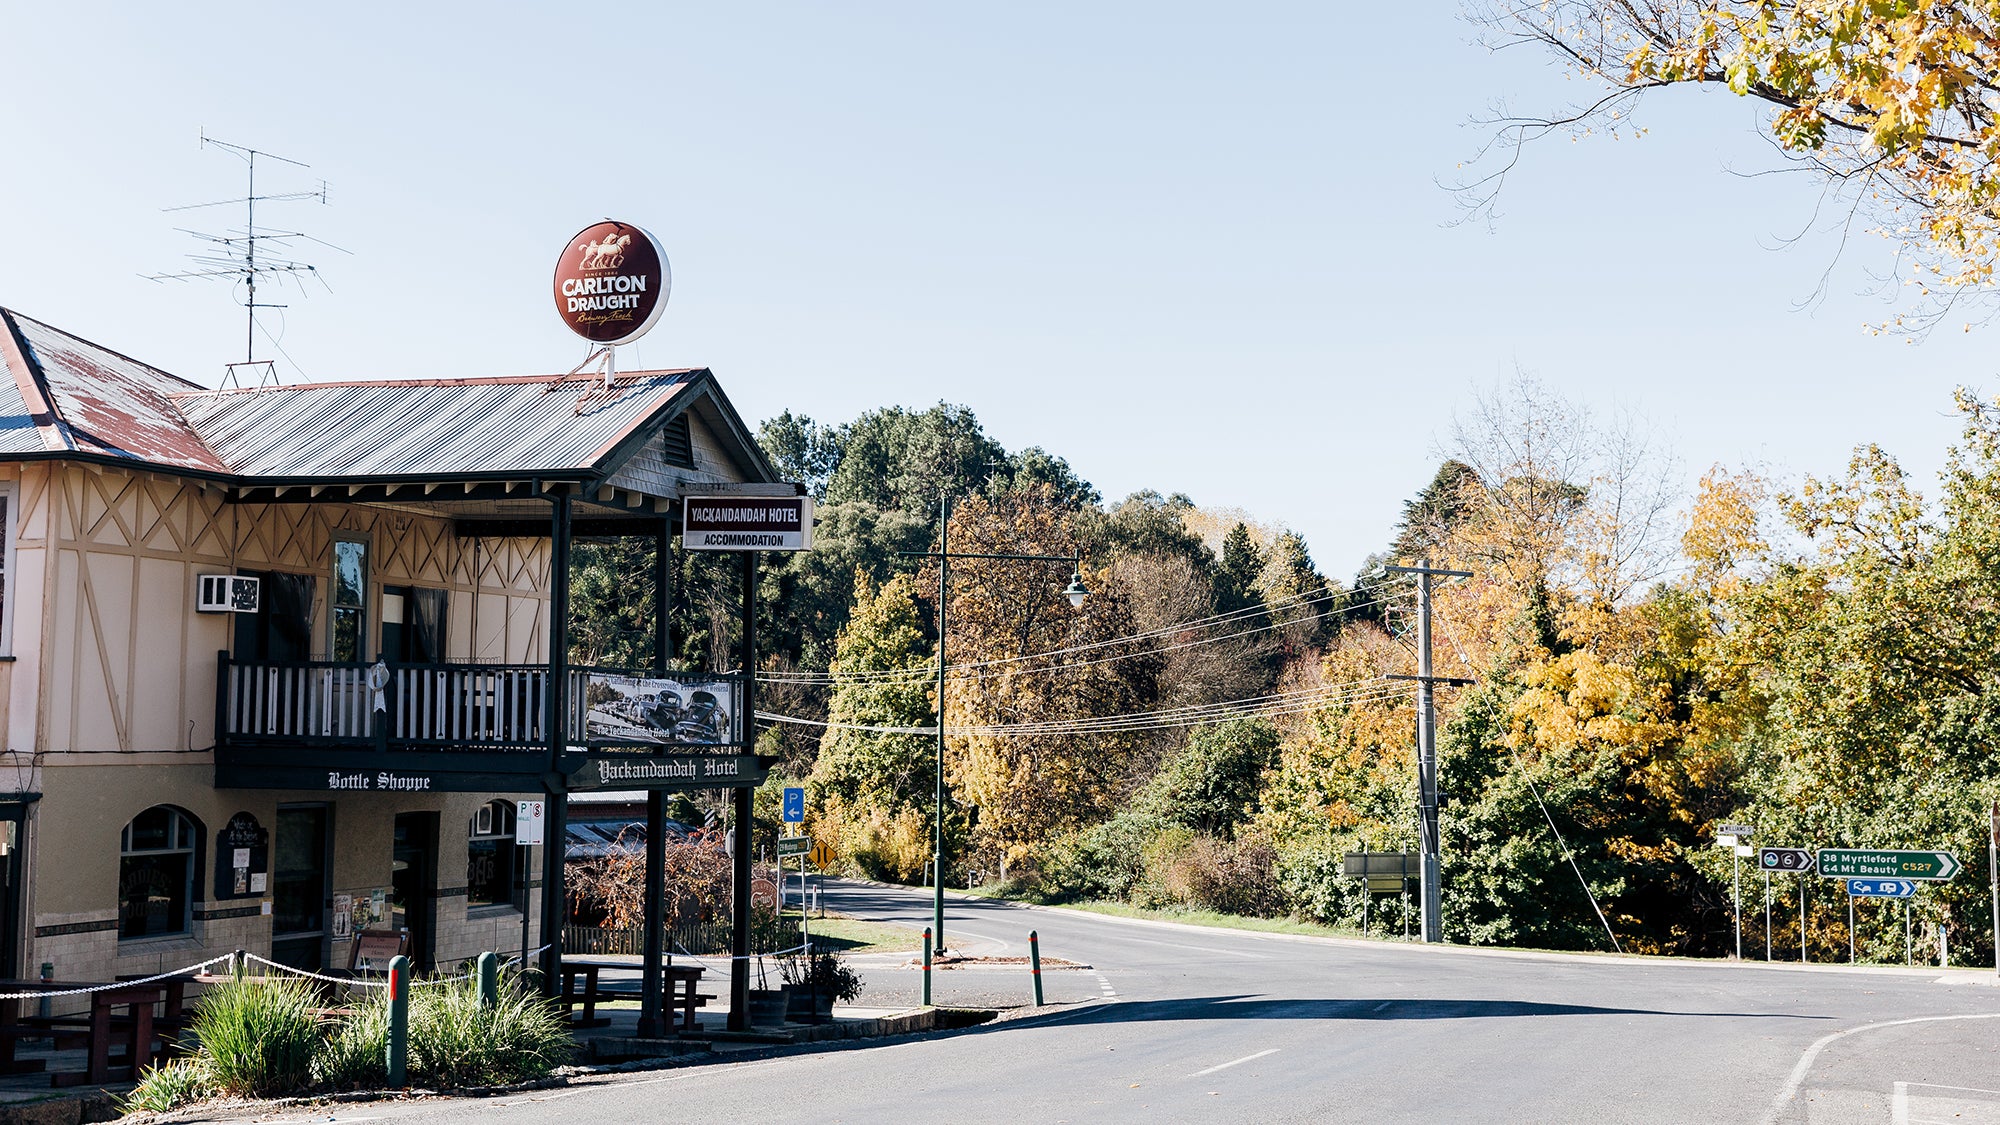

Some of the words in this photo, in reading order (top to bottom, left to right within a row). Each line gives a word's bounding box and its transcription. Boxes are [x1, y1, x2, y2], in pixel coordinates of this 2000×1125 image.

[561, 275, 647, 297] CARLTON
[567, 294, 640, 313] DRAUGHT
[691, 507, 767, 523] YACKANDANDAH
[768, 508, 799, 523] HOTEL
[703, 533, 784, 547] ACCOMMODATION
[598, 759, 697, 784] Yackandandah
[703, 758, 739, 777] Hotel
[328, 772, 370, 789] Bottle
[376, 771, 431, 791] Shoppe
[789, 792, 798, 804] P
[520, 803, 527, 813] P
[1784, 855, 1792, 865] 6
[1823, 854, 1837, 862] 38
[1841, 854, 1897, 865] Myrtleford
[468, 856, 495, 886] BAR
[1823, 864, 1838, 873] 64
[1841, 865, 1856, 873] Mt
[1860, 865, 1898, 875] Beauty
[1902, 863, 1931, 872] C527
